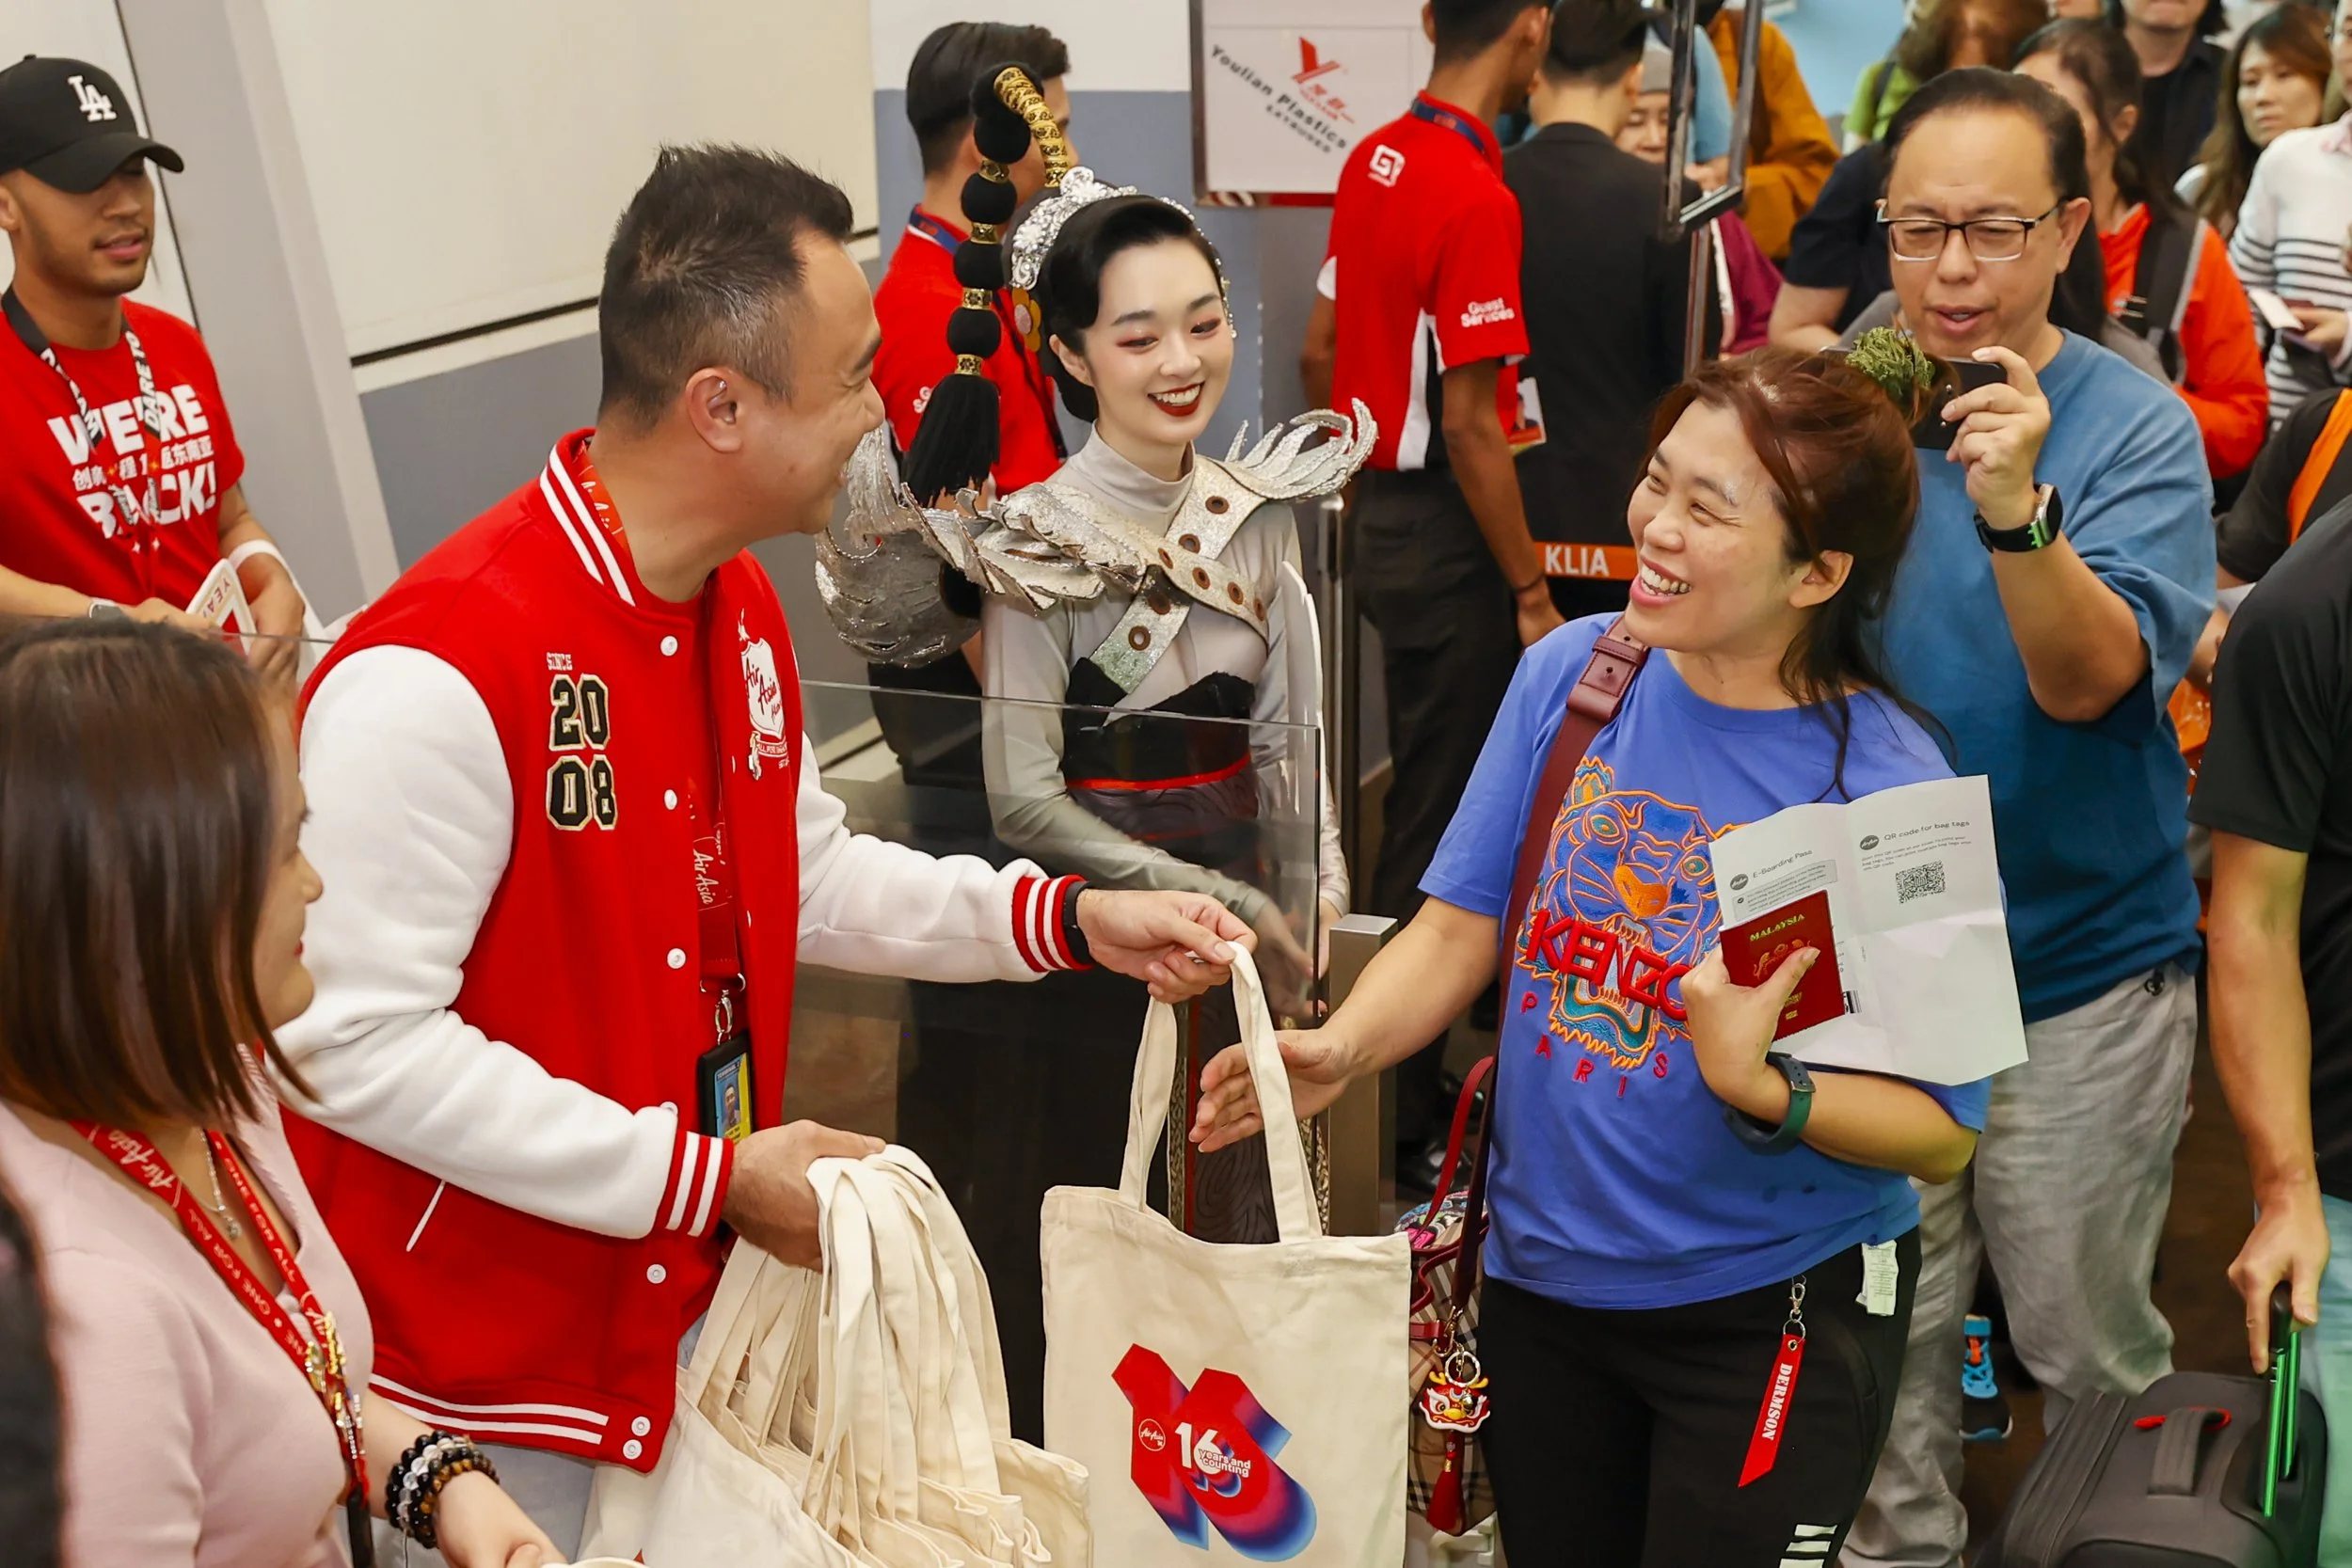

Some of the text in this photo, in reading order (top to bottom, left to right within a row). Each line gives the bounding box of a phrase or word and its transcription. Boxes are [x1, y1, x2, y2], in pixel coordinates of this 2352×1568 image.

[67, 74, 118, 123] LA
[1211, 44, 1274, 96] Youlian
[1276, 93, 1348, 150] Plastics
[1460, 307, 1516, 328] Services
[124, 330, 163, 432] DARE TO
[1544, 543, 1611, 577] KLIA
[546, 651, 574, 672] SINCE
[548, 673, 612, 752] 20
[545, 753, 619, 832] 08
[1884, 832, 1898, 841] QR
[1899, 828, 1920, 838] code
[1921, 824, 1933, 832] for
[1934, 821, 1950, 830] bag
[1752, 849, 1814, 879] E-Boarding Pass
[1750, 912, 1805, 942] MALAYSIA
[1520, 990, 1670, 1099] PARIS
[213, 1241, 242, 1280] FOR
[248, 1201, 276, 1243] FOR
[273, 1246, 297, 1284] ALL
[1761, 1362, 1794, 1442] DERMSON
[1174, 1421, 1224, 1476] 16
[1198, 1448, 1251, 1471] years and
[1201, 1457, 1250, 1479] counting
